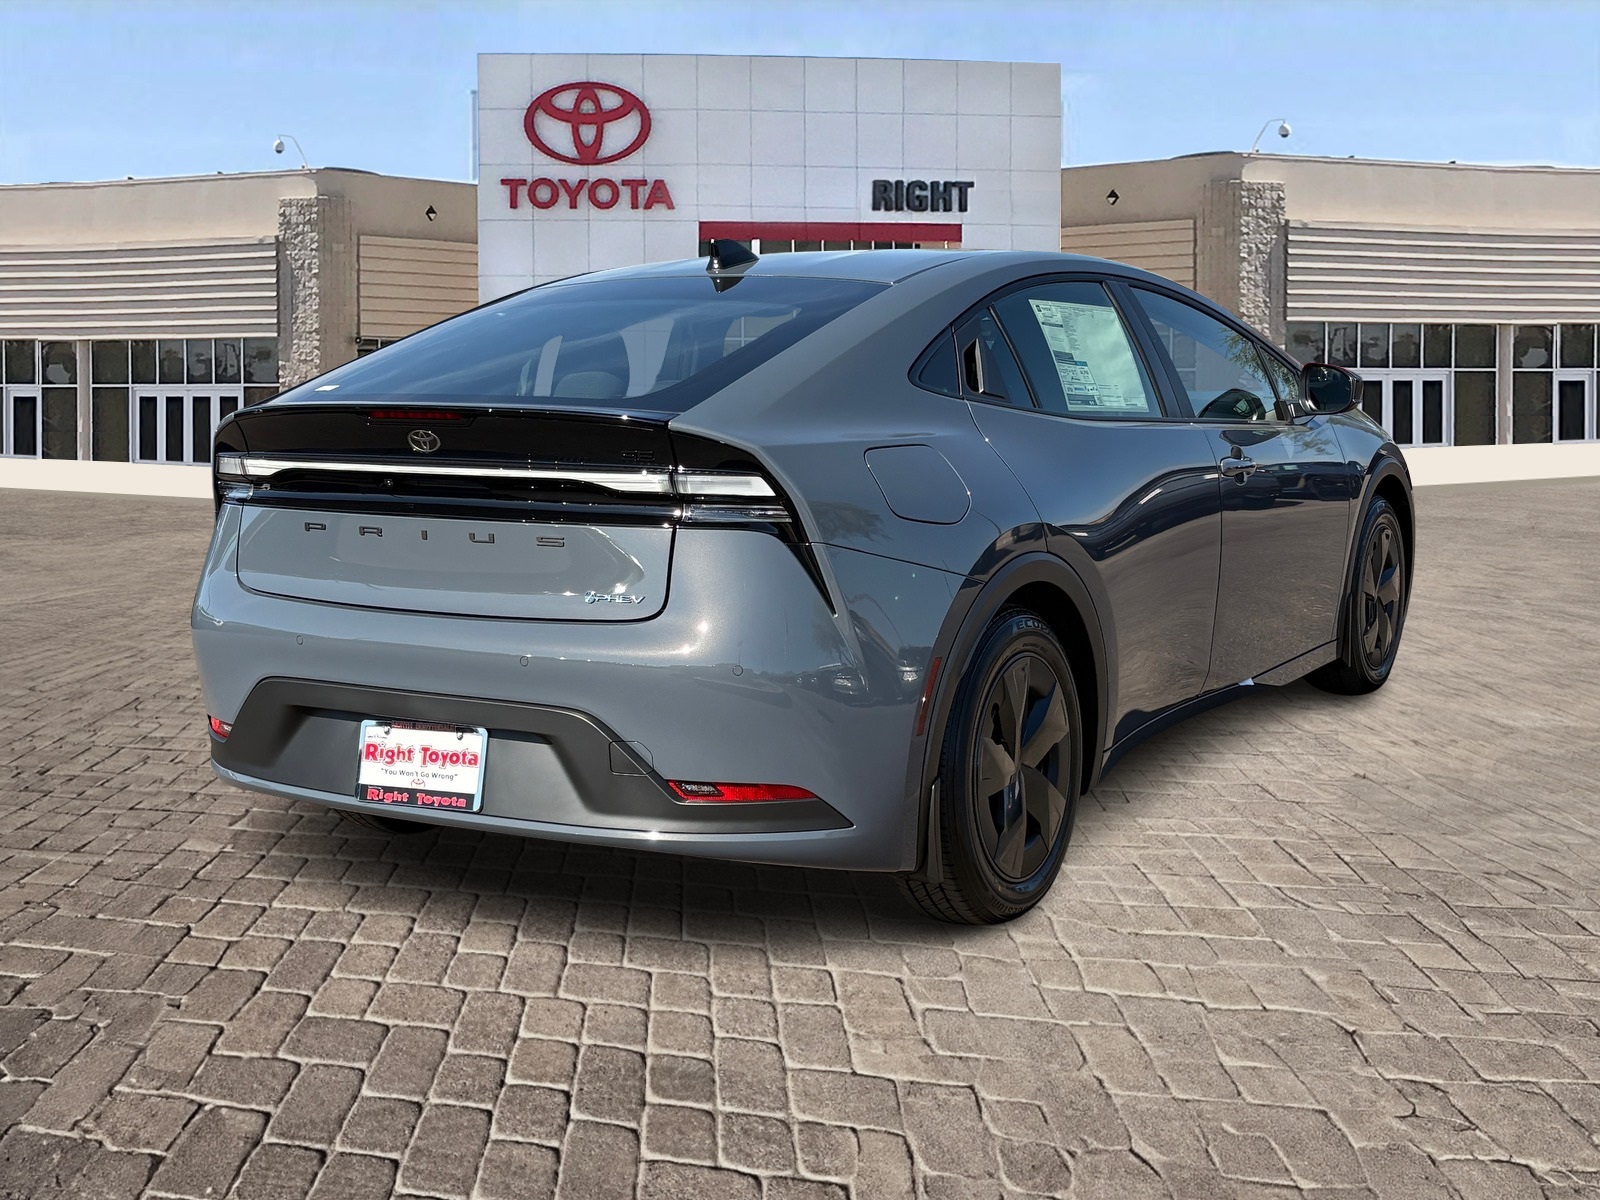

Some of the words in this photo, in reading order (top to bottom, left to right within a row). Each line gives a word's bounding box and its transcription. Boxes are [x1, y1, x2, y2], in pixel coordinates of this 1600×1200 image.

[500, 178, 675, 210] TOYOTA
[871, 179, 975, 212] RIGHT
[304, 522, 565, 548] PRIUS
[364, 742, 414, 766] Right
[420, 746, 479, 769] Toyota
[399, 769, 419, 777] Won't
[367, 788, 409, 803] Right
[416, 793, 467, 807] Toyota
